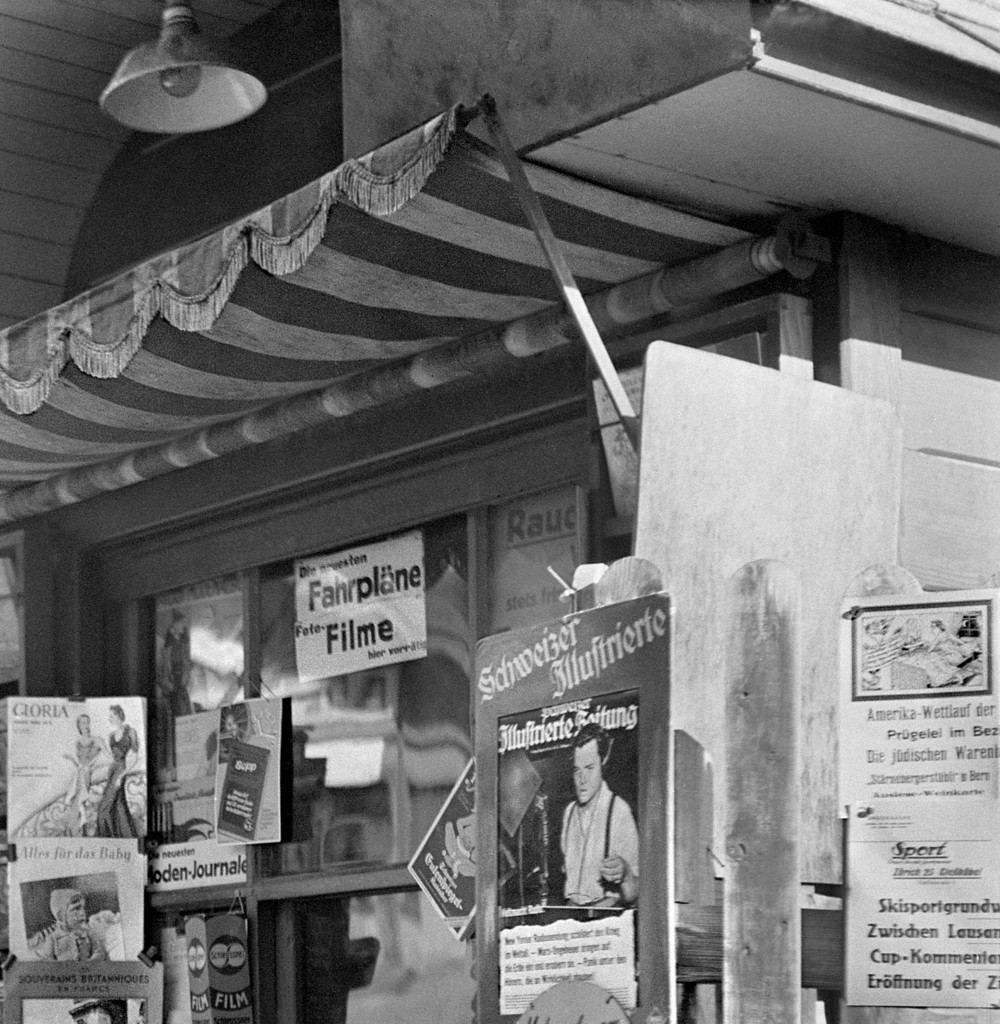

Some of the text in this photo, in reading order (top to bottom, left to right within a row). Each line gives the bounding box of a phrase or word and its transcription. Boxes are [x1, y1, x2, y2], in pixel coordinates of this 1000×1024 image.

[320, 553, 368, 570] neuesten
[309, 565, 421, 612] Fahrpläne
[327, 619, 393, 655] Filme
[479, 617, 580, 704] Schweizer
[550, 607, 666, 700] Illustrierte
[867, 703, 996, 722] Amerika-Wettlauf der
[498, 715, 574, 754] Illustrierte
[888, 728, 942, 741] Prügelei
[950, 727, 965, 738] im
[867, 749, 885, 763] Die
[891, 748, 947, 765] jüdischen
[22, 846, 49, 859] Alles
[54, 848, 70, 861] für
[76, 847, 95, 859] das
[99, 847, 131, 862] Baby
[162, 847, 195, 859] neuesten
[891, 841, 948, 860] Sport
[868, 923, 939, 939] Zwischen
[81, 974, 150, 984] BRITANNIQUES
[867, 973, 943, 992] Eröffnung
[952, 975, 978, 990] der
[191, 994, 209, 1011] FILM
[215, 992, 249, 1010] FILM
